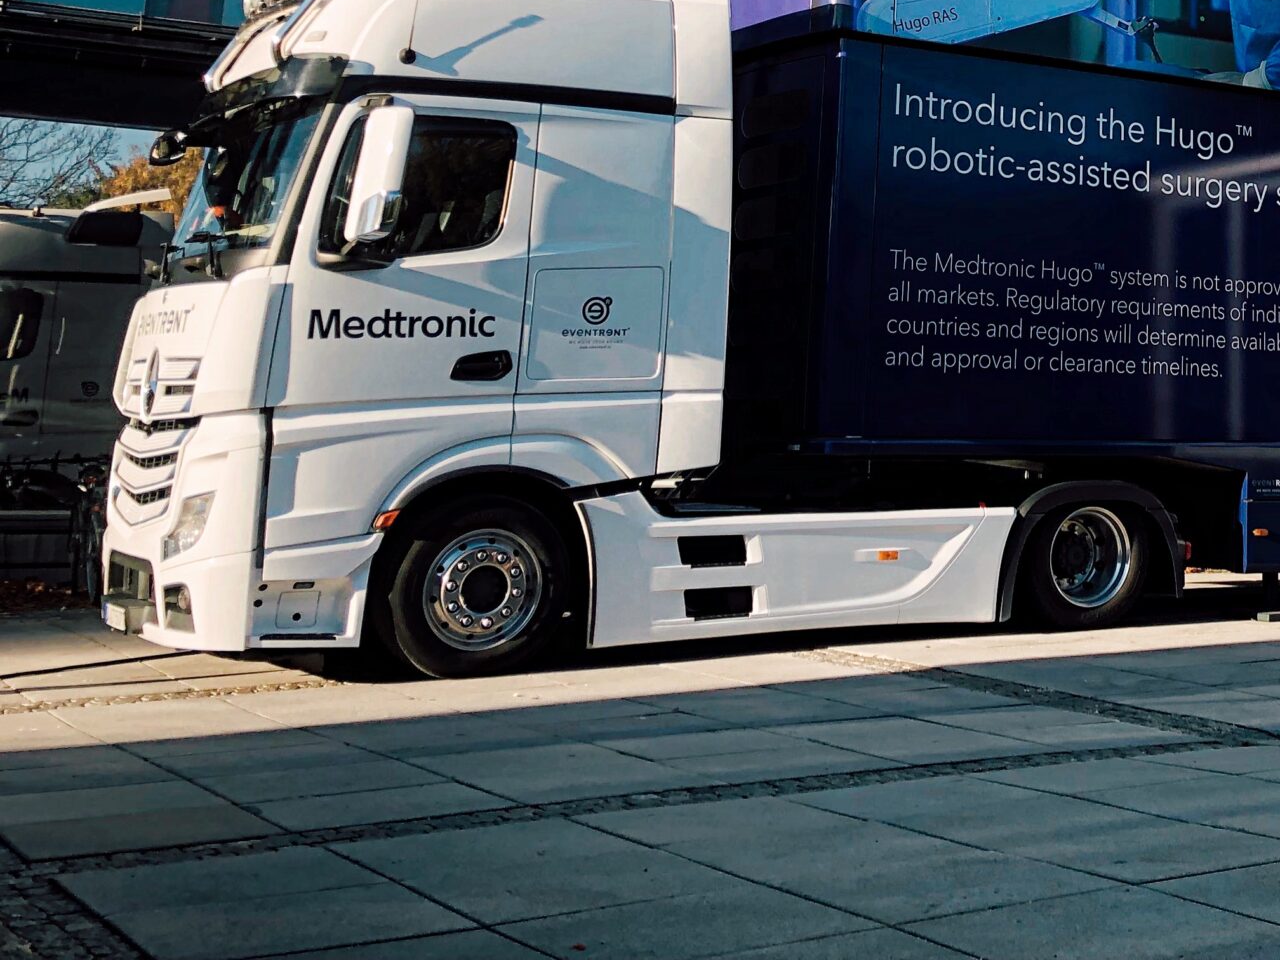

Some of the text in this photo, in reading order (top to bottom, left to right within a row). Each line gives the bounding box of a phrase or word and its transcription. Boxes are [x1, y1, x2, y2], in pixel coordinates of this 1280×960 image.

[895, 7, 958, 33] Hugo RAS
[895, 83, 1086, 145] Introducing
[1096, 108, 1145, 144] the
[893, 137, 1151, 192] robotic-assisted
[1161, 168, 1268, 212] surgery
[890, 249, 928, 272] The
[935, 252, 1036, 279] Medtronic
[1110, 270, 1169, 292] system
[1175, 273, 1187, 289] is
[1193, 273, 1220, 292] not
[888, 280, 911, 302] all
[917, 284, 999, 307] markets.
[1006, 288, 1105, 319] Regulatory
[1111, 298, 1224, 322] requirements
[1230, 301, 1247, 321] of
[307, 307, 496, 340] Medtronic
[887, 315, 980, 338] countries
[986, 318, 1022, 339] and
[1029, 322, 1098, 346] regions
[1104, 324, 1131, 344] will
[1138, 325, 1226, 348] determine
[885, 345, 1223, 378] and approval or clearance timelines.
